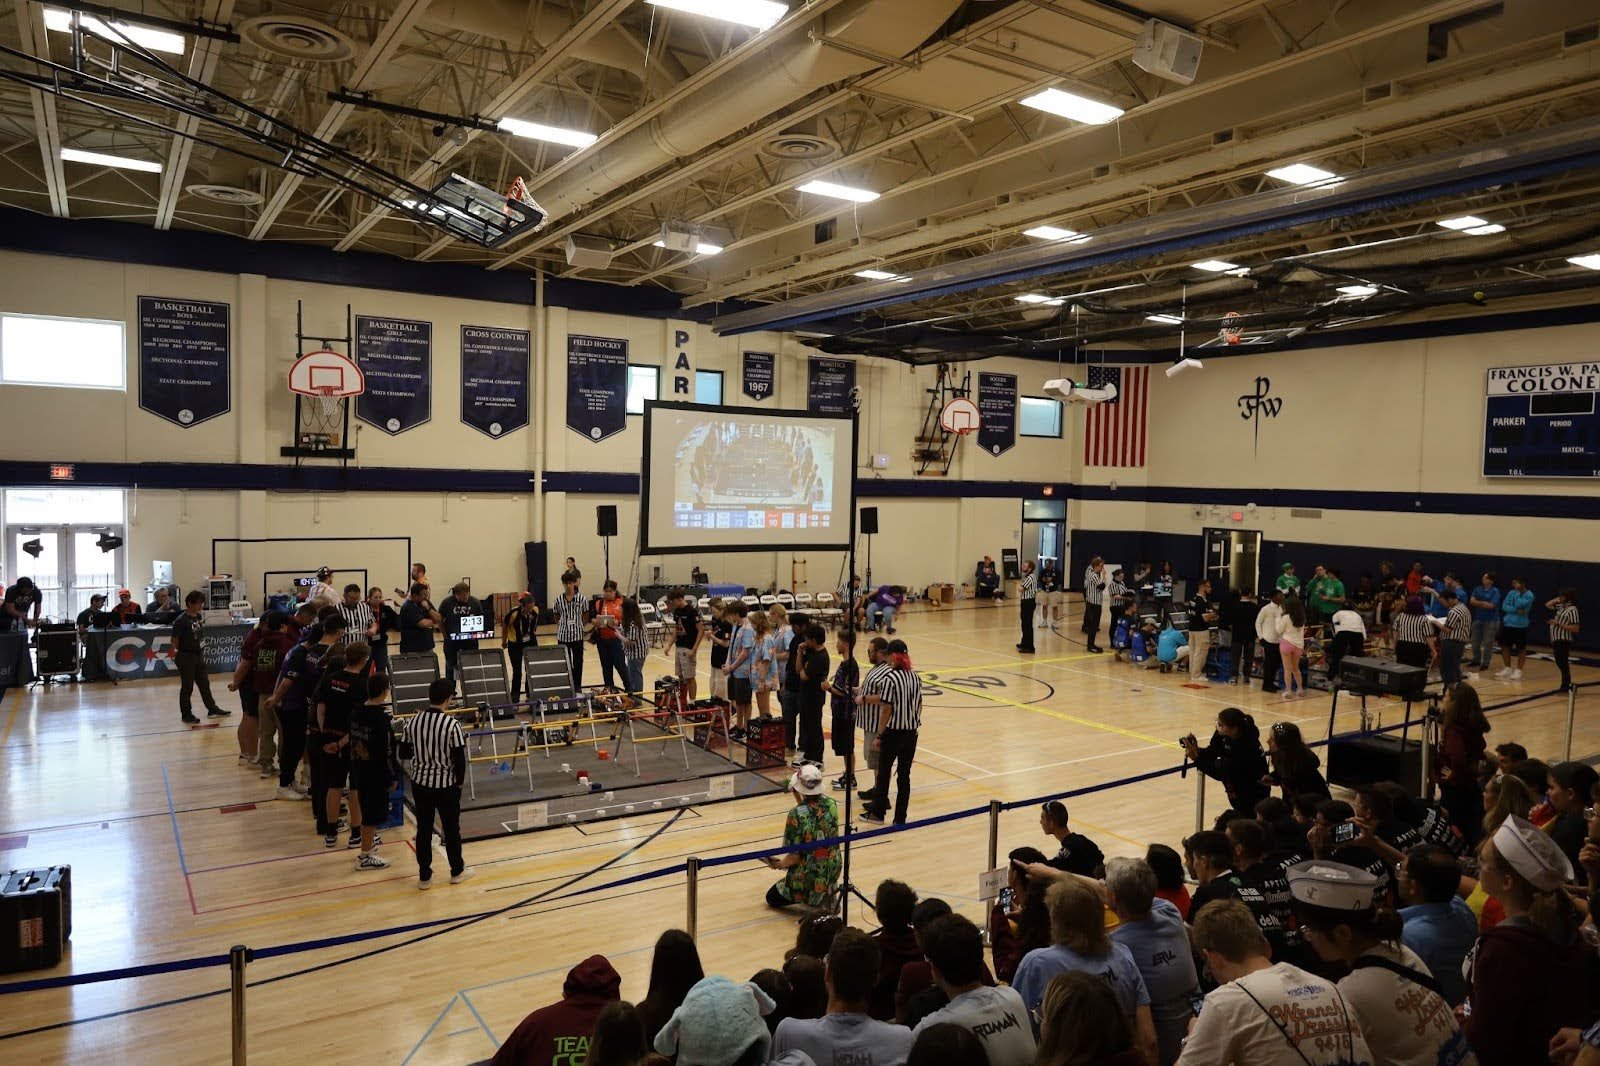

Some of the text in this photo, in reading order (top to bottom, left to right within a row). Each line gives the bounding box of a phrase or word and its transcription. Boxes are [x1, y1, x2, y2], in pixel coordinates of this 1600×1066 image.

[154, 302, 215, 314] BASKETBALL
[152, 317, 191, 326] CONFERENCE
[192, 320, 226, 328] CHAMPIONS
[369, 321, 420, 332] BASKETBALL
[465, 330, 526, 341] CROSS COUNTRY
[573, 339, 622, 349] FIELD HOCKEY
[151, 356, 183, 364] SECTIONAL
[674, 330, 691, 402] PAR
[1491, 367, 1553, 380] FRANCIS
[1558, 365, 1575, 376] W.
[748, 382, 769, 392] 1967
[1506, 376, 1600, 393] COLONE
[1492, 416, 1526, 427] PARKER
[1561, 446, 1585, 454] MATCH
[462, 617, 482, 626] 2:13
[202, 634, 244, 646] Chicago
[972, 1011, 1021, 1042] ROMAN
[553, 1035, 593, 1054] TEA
